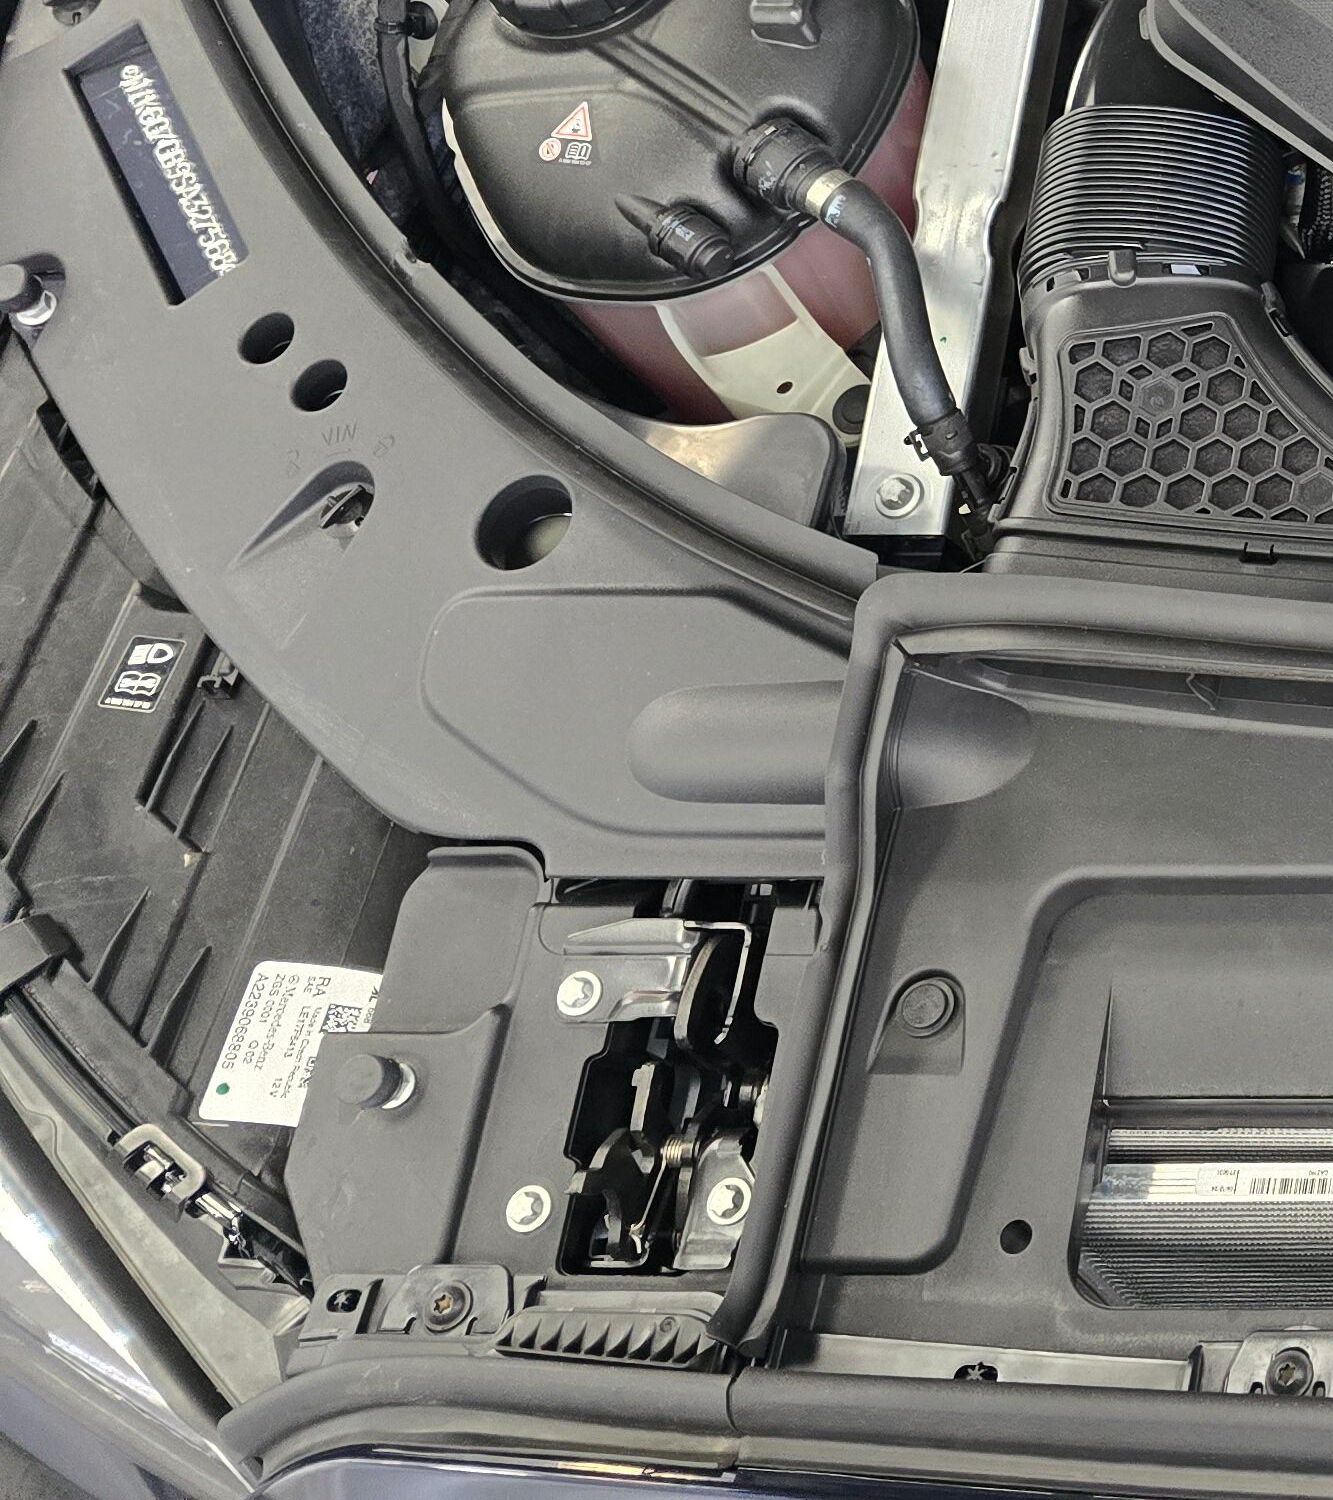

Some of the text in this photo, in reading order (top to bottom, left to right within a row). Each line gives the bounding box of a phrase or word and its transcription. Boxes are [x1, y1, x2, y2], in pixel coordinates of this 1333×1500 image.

[268, 973, 286, 997] ZGS
[303, 976, 316, 995] SAE
[312, 976, 332, 998] RA
[220, 972, 270, 1071] A2239068805
[259, 1000, 276, 1024] 0001
[253, 986, 297, 1072] Mercedes-Benz
[242, 1050, 256, 1066] 02
[272, 1076, 283, 1090] 12
